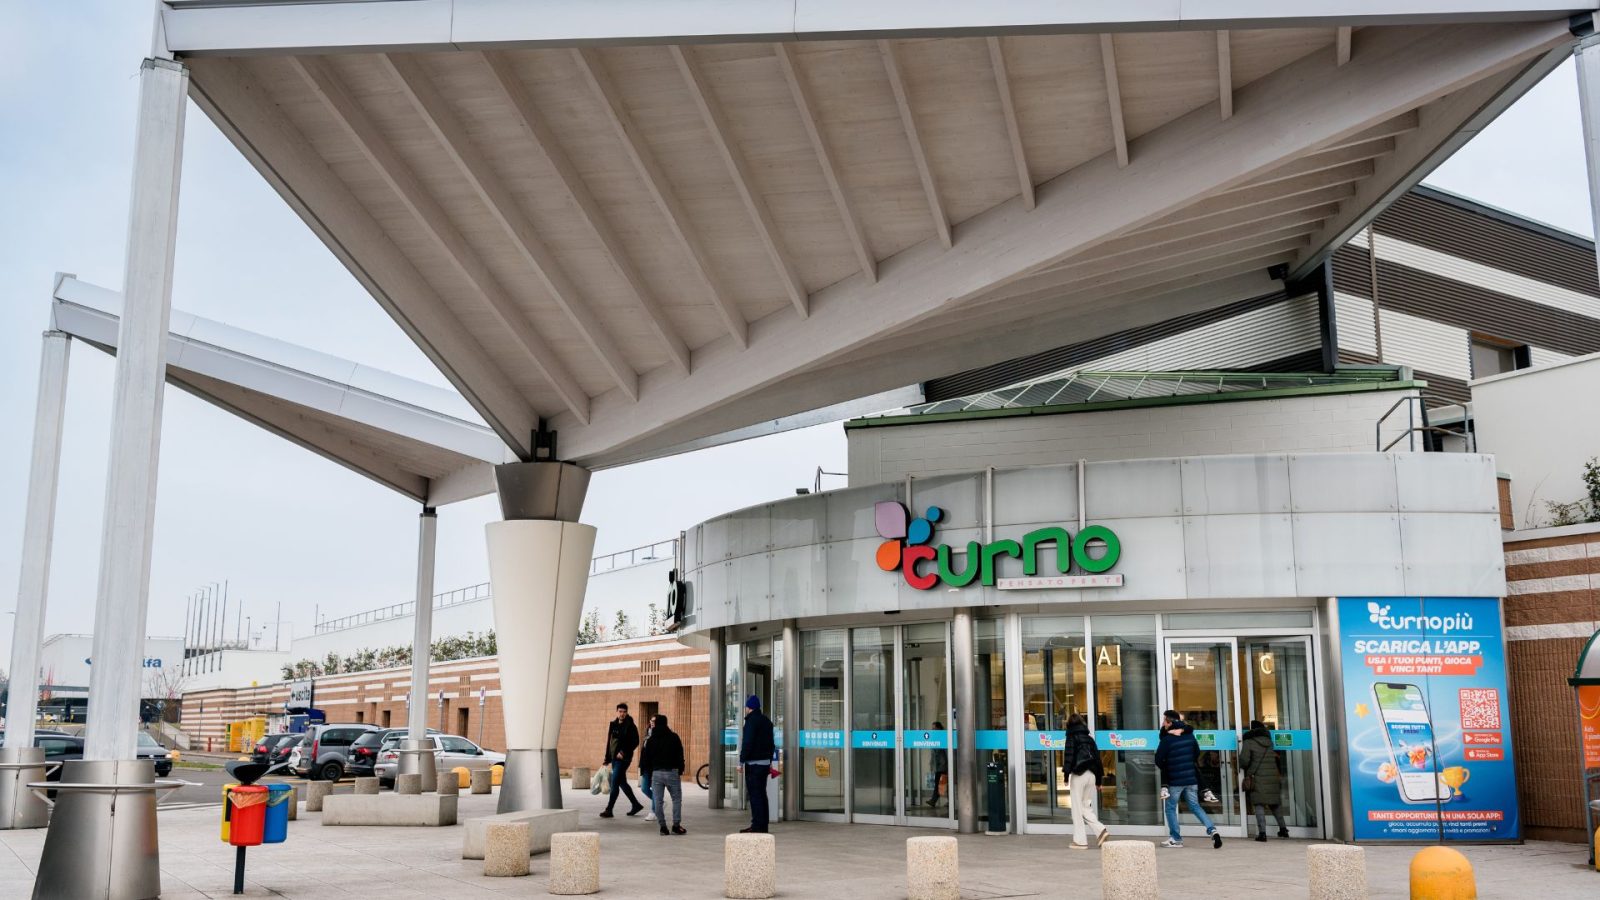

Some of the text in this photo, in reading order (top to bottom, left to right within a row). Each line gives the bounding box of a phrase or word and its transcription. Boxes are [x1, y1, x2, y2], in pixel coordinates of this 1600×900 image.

[902, 524, 1121, 591] curno
[999, 576, 1121, 588] PENSATO PER TE
[1378, 612, 1473, 634] curnopiù
[1354, 640, 1432, 654] SCARICA
[1367, 656, 1386, 665] USA
[1393, 656, 1414, 665] TUOI
[1444, 656, 1472, 665] GIOCA
[1376, 665, 1442, 673] E VINCI TANTI
[1490, 736, 1500, 744] Play
[1475, 752, 1486, 760] App
[1372, 812, 1395, 820] TANTE
[1451, 812, 1467, 820] UNA
[1467, 811, 1486, 820] SOLA
